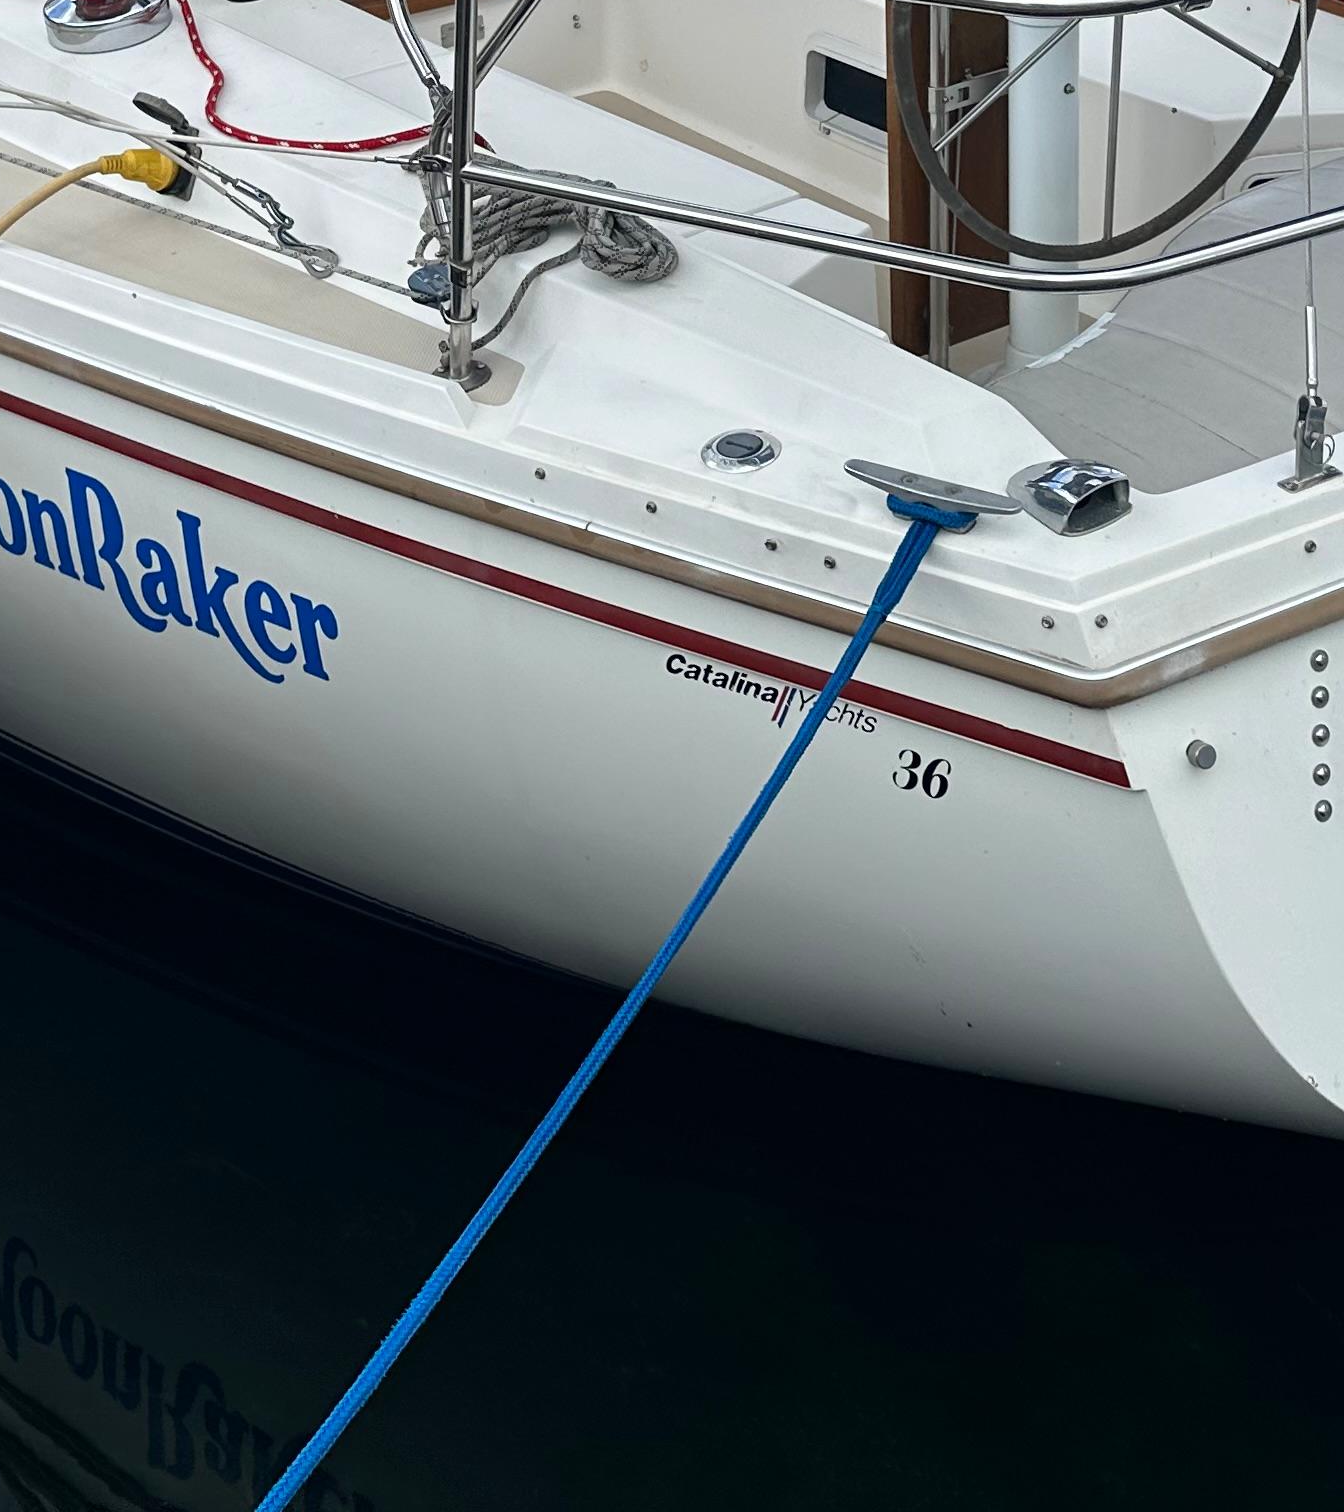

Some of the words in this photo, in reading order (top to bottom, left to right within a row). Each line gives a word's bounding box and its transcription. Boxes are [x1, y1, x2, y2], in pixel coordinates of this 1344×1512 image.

[665, 653, 779, 704] Catalina
[798, 689, 878, 733] Ychts
[892, 749, 952, 799] 36
